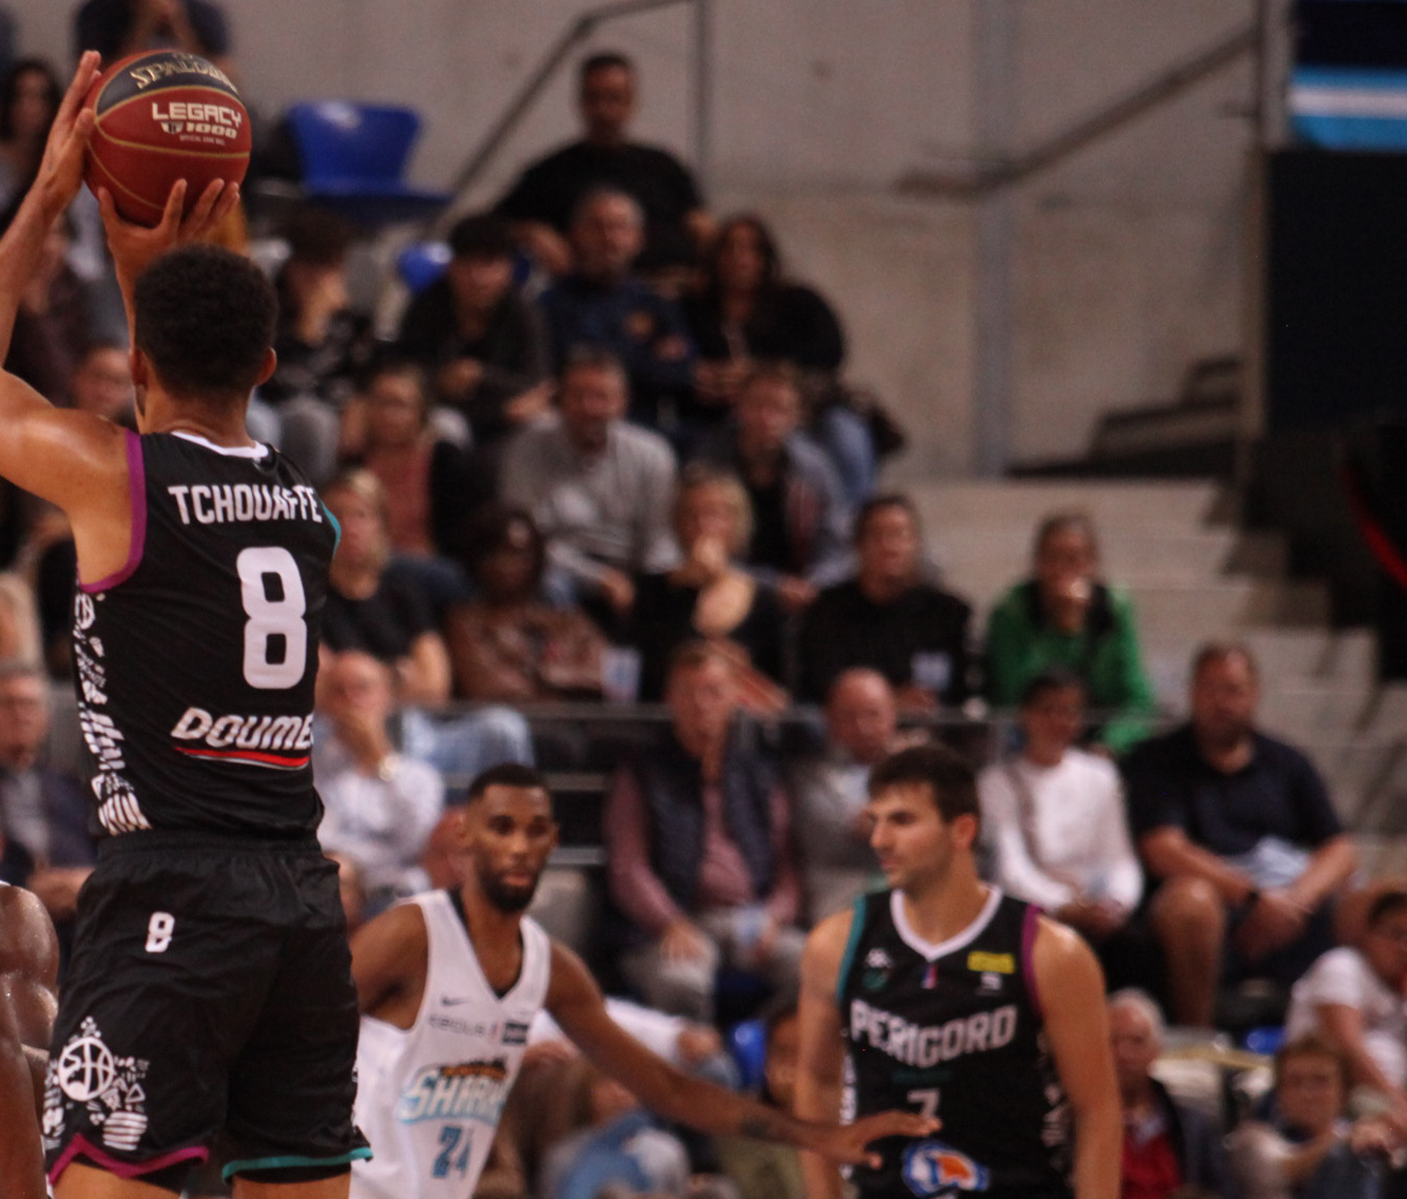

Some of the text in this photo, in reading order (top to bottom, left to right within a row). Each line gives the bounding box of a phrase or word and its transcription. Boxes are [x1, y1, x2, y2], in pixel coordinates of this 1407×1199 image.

[152, 102, 242, 127] LEGACY
[186, 123, 237, 139] 1000
[236, 546, 307, 689] 8
[145, 911, 175, 953] 8
[851, 998, 1018, 1069] PERIGORD
